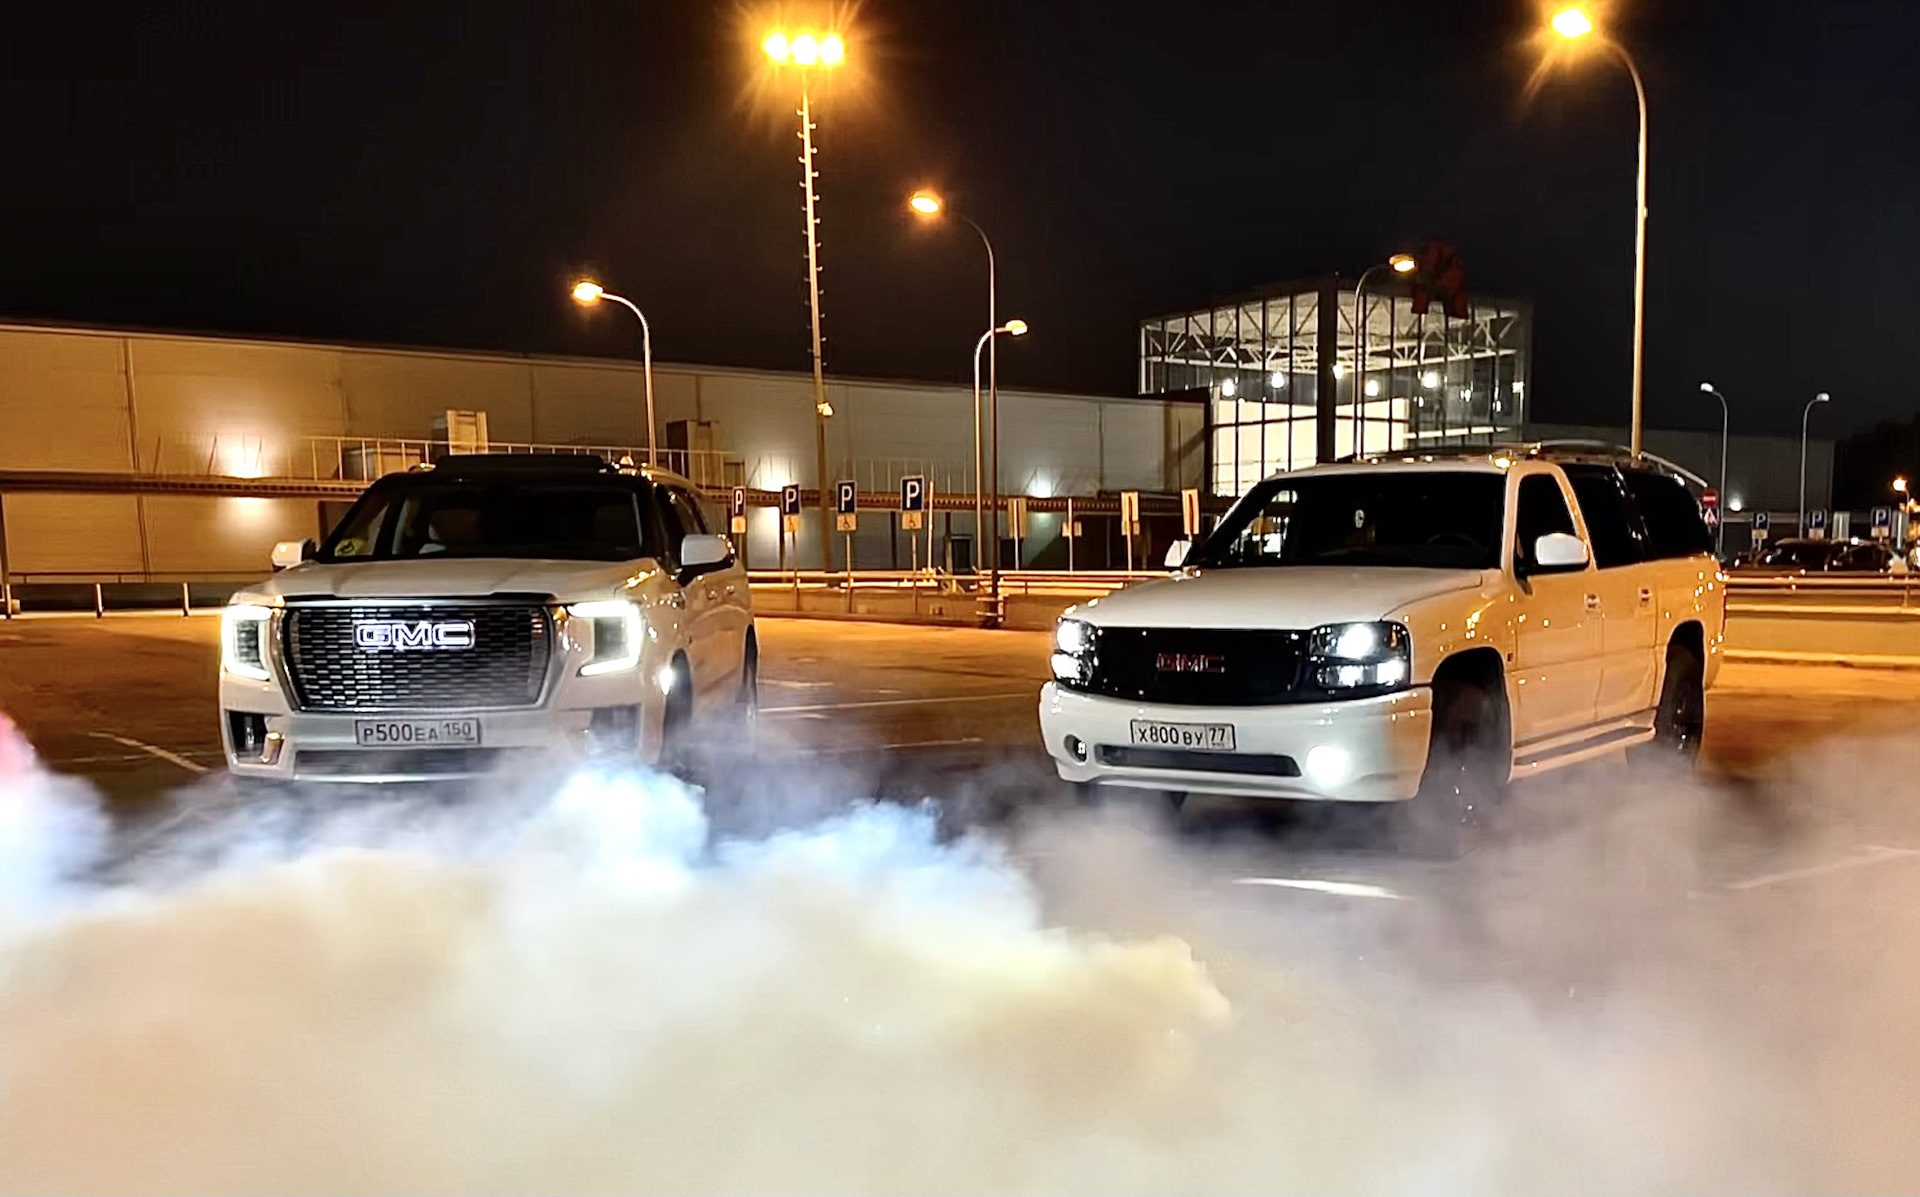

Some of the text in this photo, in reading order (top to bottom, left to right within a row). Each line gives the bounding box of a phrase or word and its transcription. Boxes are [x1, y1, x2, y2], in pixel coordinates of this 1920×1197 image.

[735, 489, 743, 514] P
[785, 488, 797, 513] P
[841, 485, 852, 511] P
[906, 480, 919, 508] P
[1756, 513, 1766, 528] P
[1875, 509, 1887, 525] P
[356, 623, 470, 647] GMC
[1156, 653, 1225, 673] GMC
[443, 722, 471, 736] 150
[1209, 728, 1225, 742] 77
